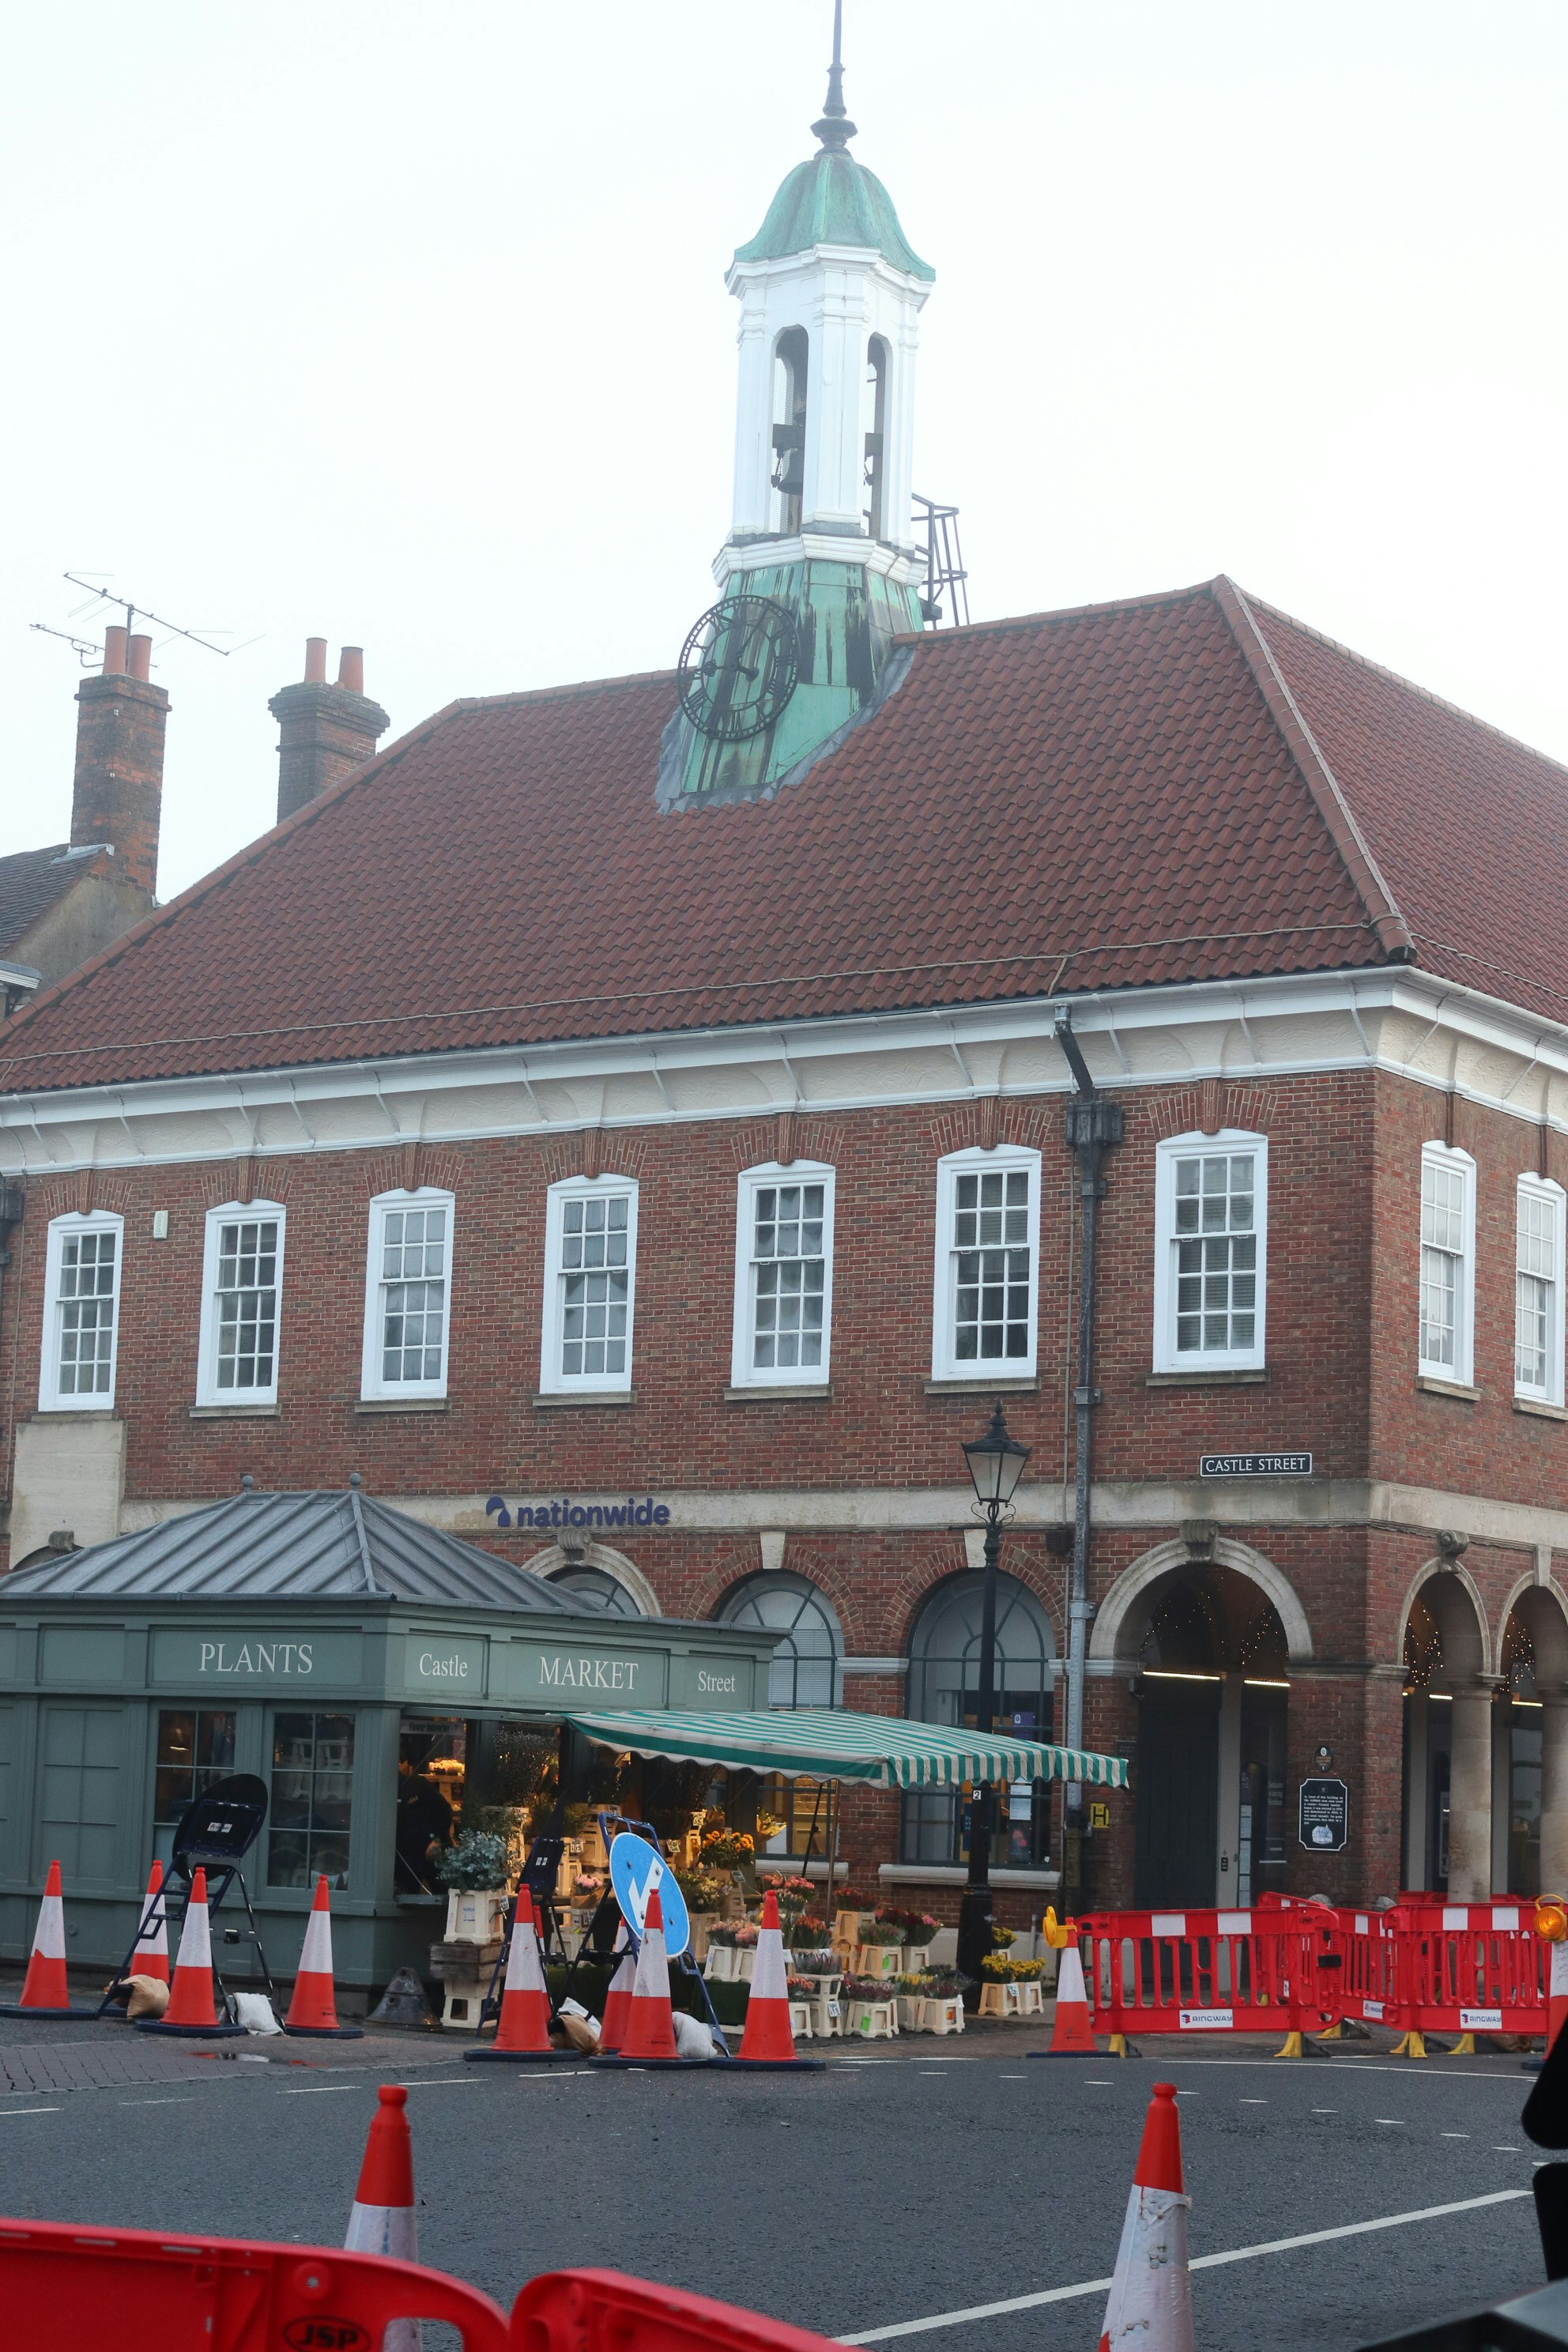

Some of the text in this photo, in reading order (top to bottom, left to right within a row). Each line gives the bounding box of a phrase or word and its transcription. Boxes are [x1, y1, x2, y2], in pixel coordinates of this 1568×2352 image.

[1205, 1457, 1306, 1472] CASTLE STREET
[518, 1498, 669, 1528] nationwide
[198, 1643, 313, 1674] PLANTS
[420, 1653, 468, 1678] Castle
[538, 1657, 639, 1690] MARKET
[698, 1671, 736, 1693] Street
[1093, 1806, 1106, 1826] H
[298, 2324, 359, 2350] JSP
